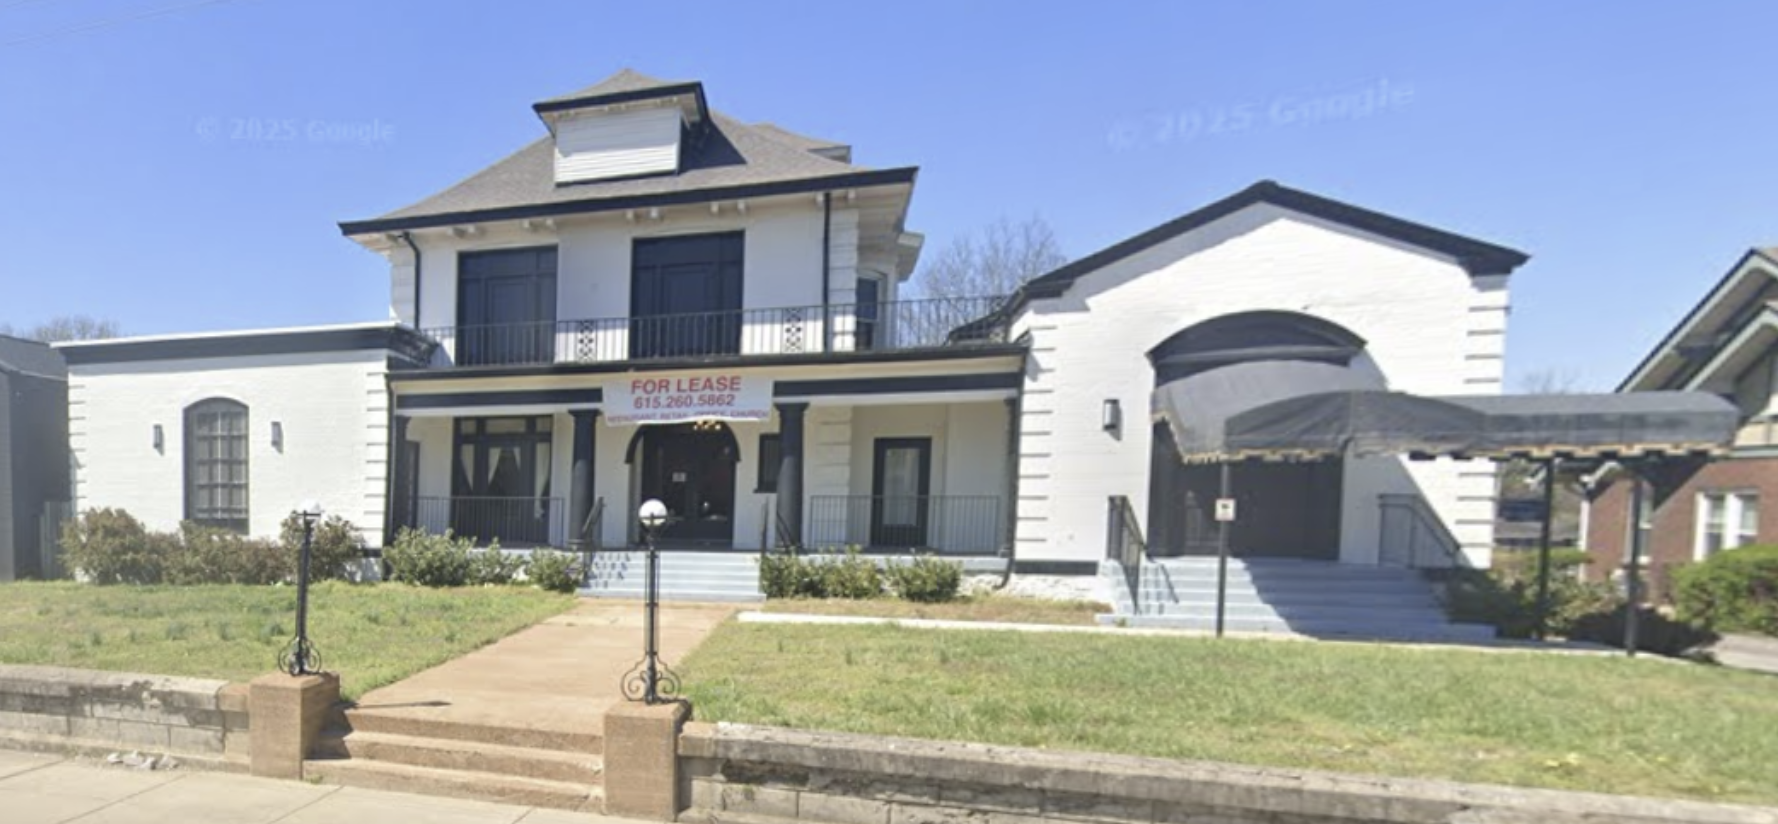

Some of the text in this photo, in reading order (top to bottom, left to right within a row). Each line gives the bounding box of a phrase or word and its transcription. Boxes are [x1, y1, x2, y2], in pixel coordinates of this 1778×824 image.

[631, 376, 741, 395] FOR LEASE
[634, 394, 736, 409] 615.260.5862
